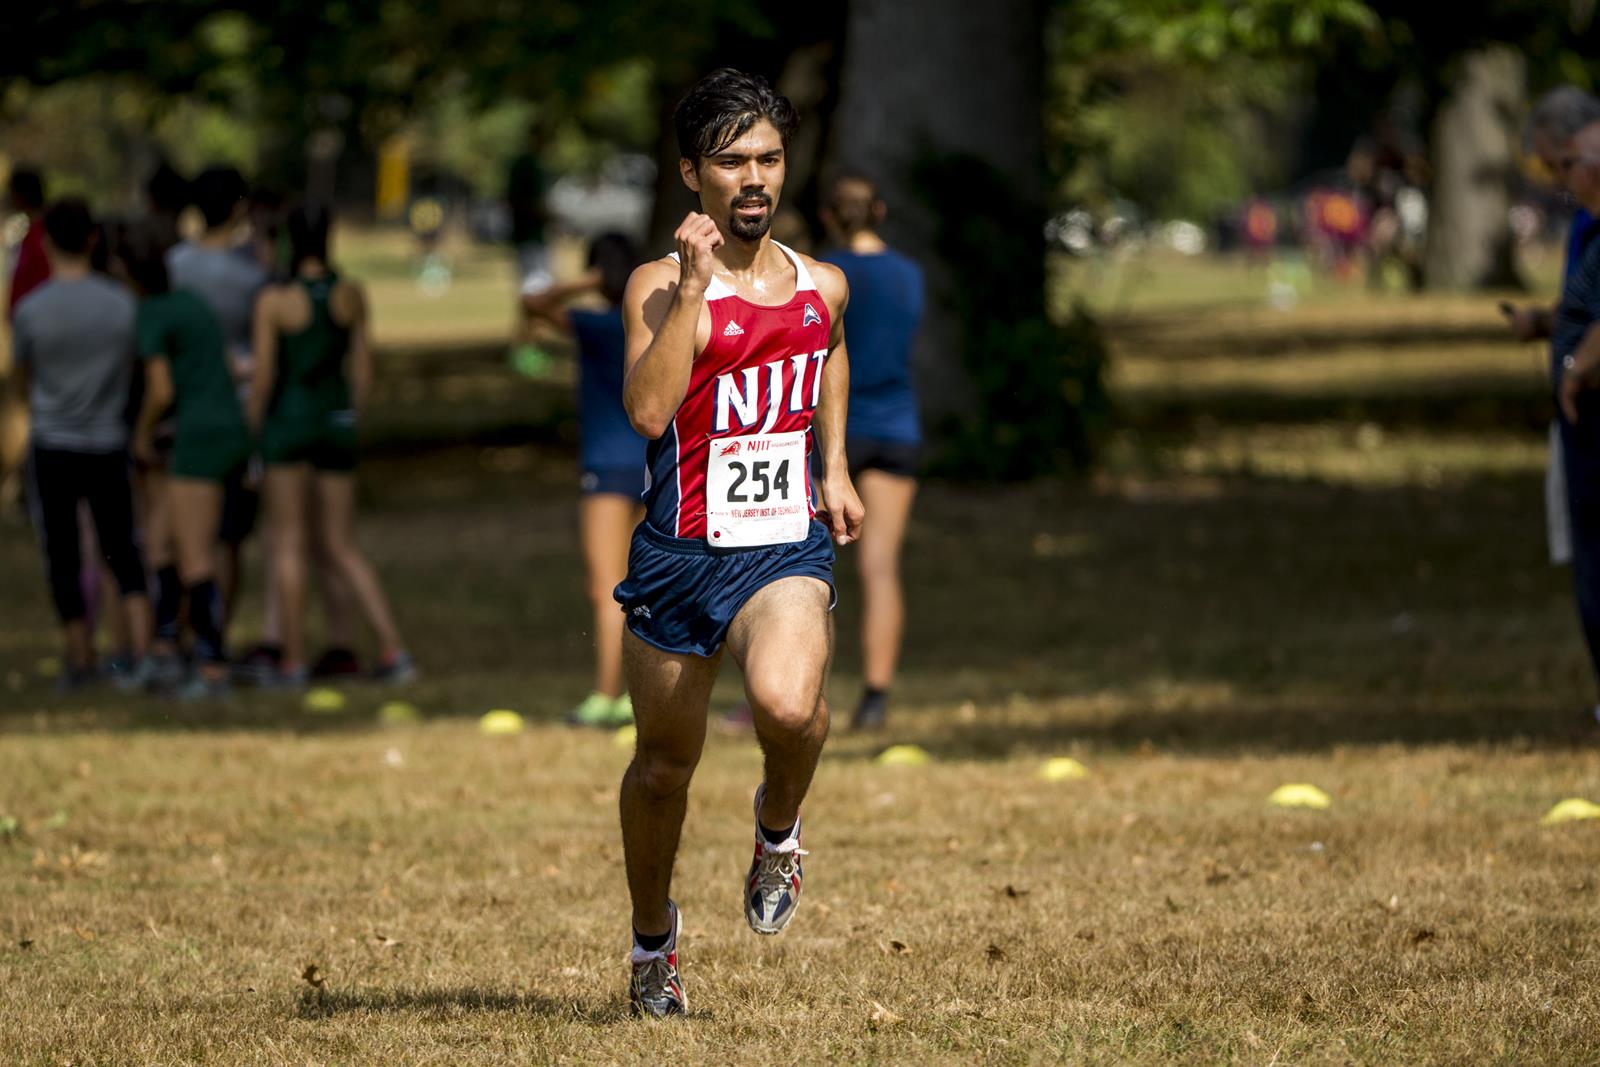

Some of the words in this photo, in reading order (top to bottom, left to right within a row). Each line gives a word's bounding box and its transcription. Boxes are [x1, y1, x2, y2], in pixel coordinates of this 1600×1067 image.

[712, 348, 829, 435] NJIT
[747, 440, 771, 453] NJIT
[727, 459, 790, 503] 254
[742, 508, 759, 518] JERSEY
